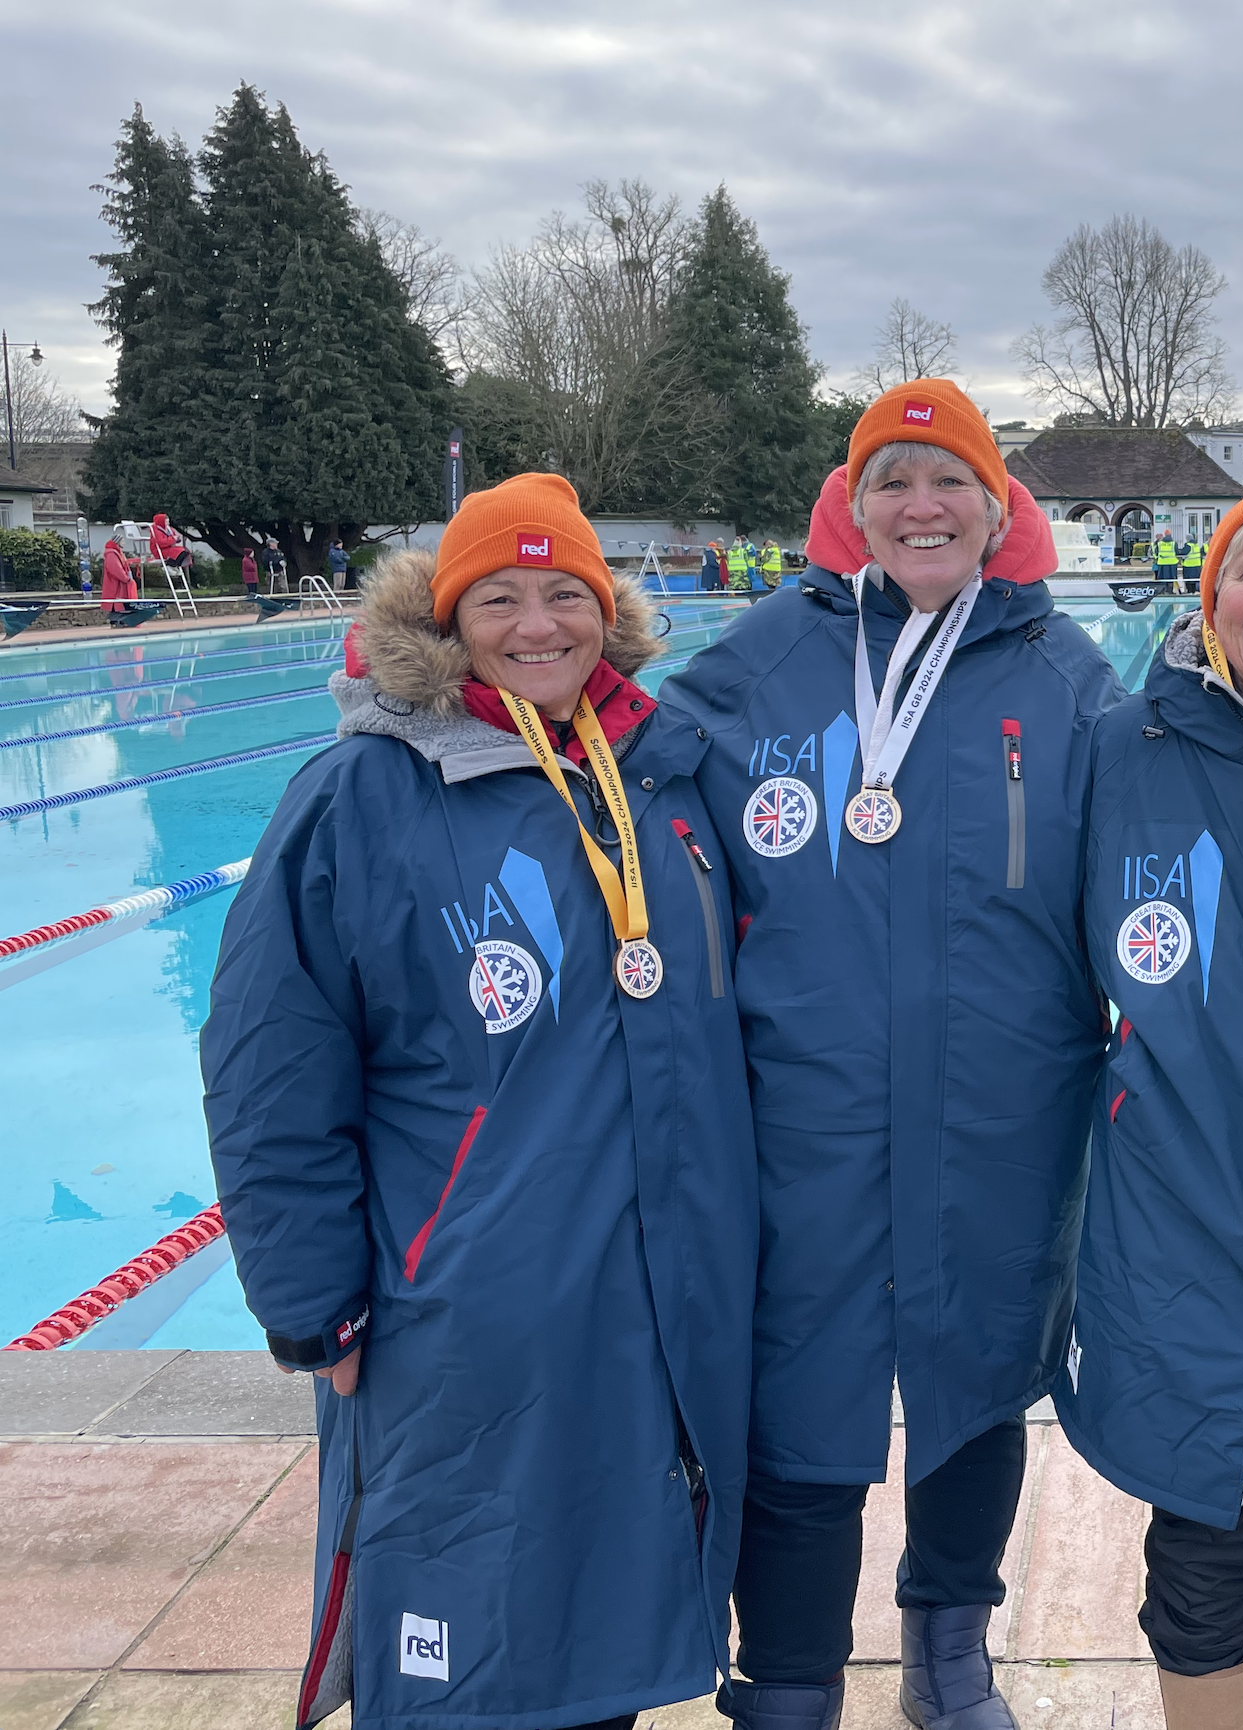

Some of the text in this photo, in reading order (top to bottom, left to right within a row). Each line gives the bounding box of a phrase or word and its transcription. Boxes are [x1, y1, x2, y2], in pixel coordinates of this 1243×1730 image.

[906, 407, 932, 421] red
[521, 538, 548, 556] red
[1118, 586, 1155, 597] speedo
[1207, 632, 1215, 644] GB
[901, 600, 968, 729] IISA GB 2024 CHAMPIONSHIPS
[511, 693, 548, 764] AMPIONSHIPS
[749, 733, 816, 777] IISA
[755, 779, 808, 800] GREAT BRITAIN
[590, 738, 638, 888] IISA GB 2024 CHAMPIONSHIPS
[752, 835, 806, 855] ICE SWIMMING
[1123, 853, 1186, 900] IISA
[1130, 904, 1180, 924] GREAT BRITAIN
[476, 943, 517, 955] BRITAIN
[1127, 961, 1180, 982] ICE SWIMMING
[491, 994, 538, 1031] SWIMMING
[340, 1320, 353, 1342] red
[407, 1620, 443, 1661] red
